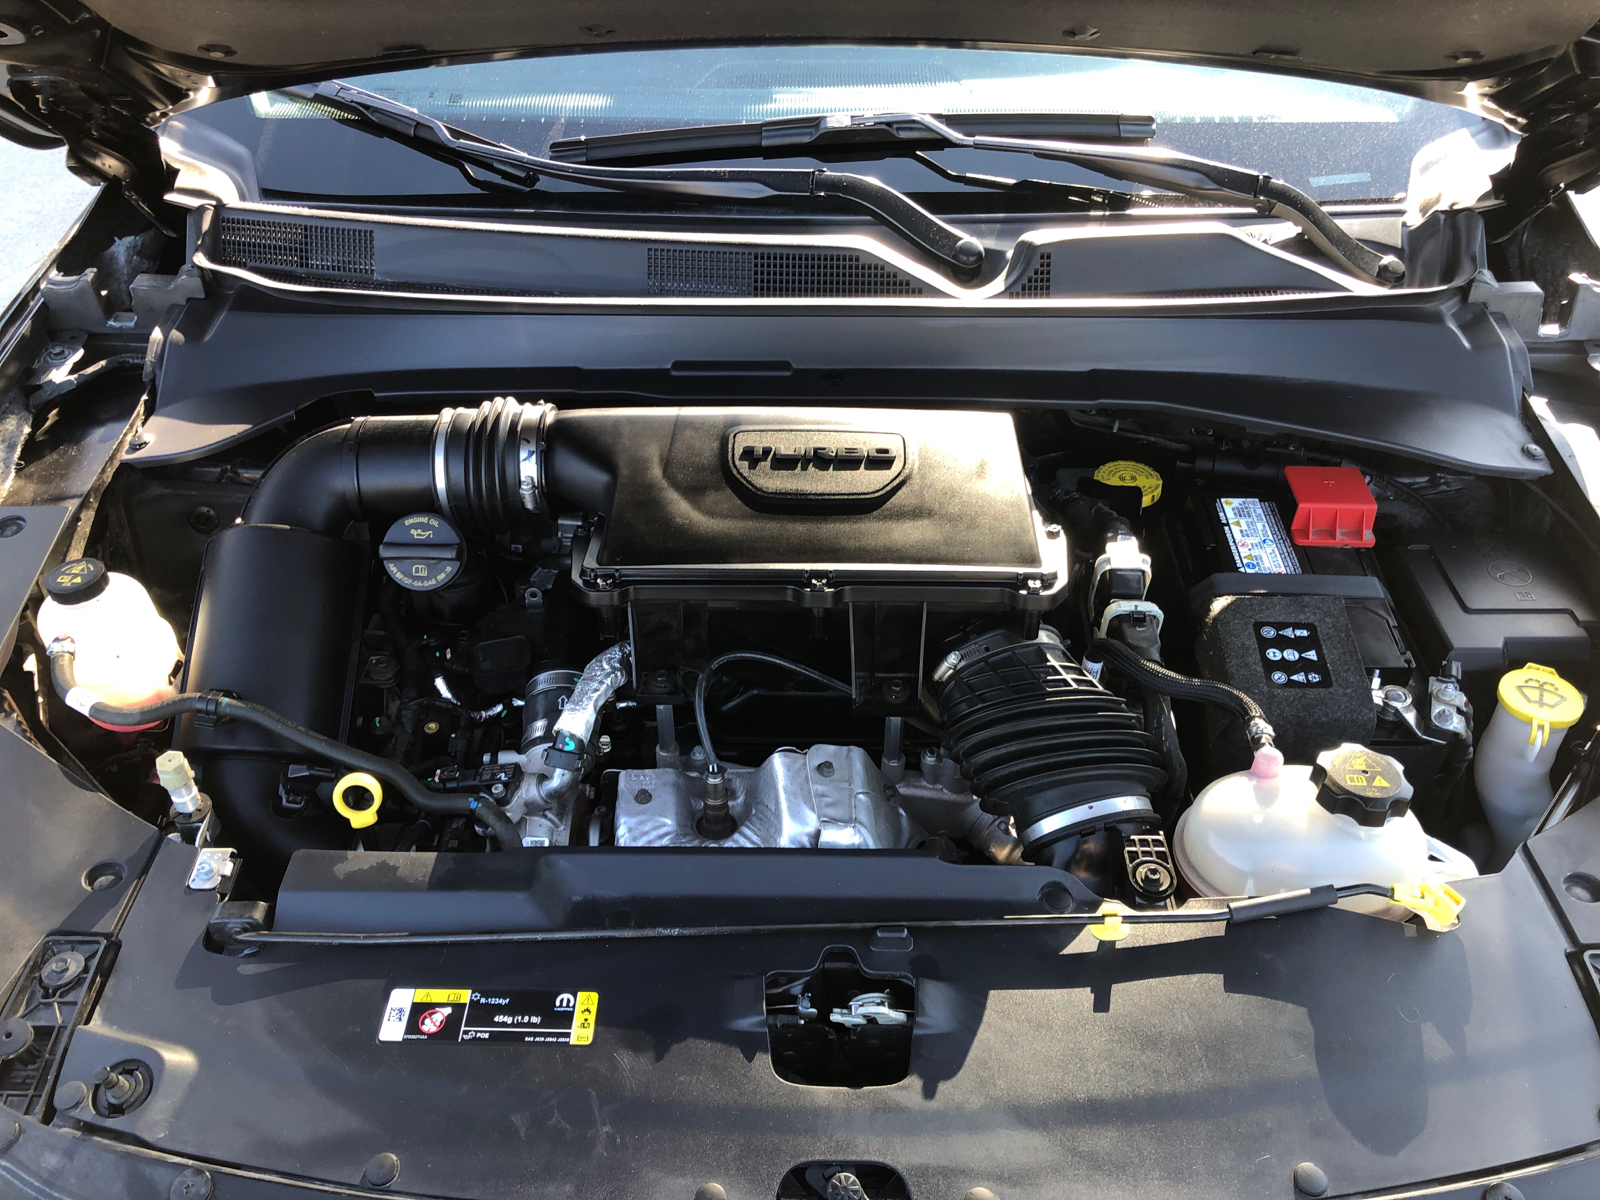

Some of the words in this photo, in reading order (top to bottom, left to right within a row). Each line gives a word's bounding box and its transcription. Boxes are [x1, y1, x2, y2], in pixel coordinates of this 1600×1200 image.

[739, 445, 897, 466] TURBO
[404, 517, 429, 526] ENGINE
[429, 519, 439, 528] OIL
[388, 563, 396, 575] API
[479, 997, 510, 1006] R-1234yf
[493, 1014, 513, 1025] 454g
[514, 1015, 529, 1025] (1.0
[530, 1015, 542, 1025] lb)
